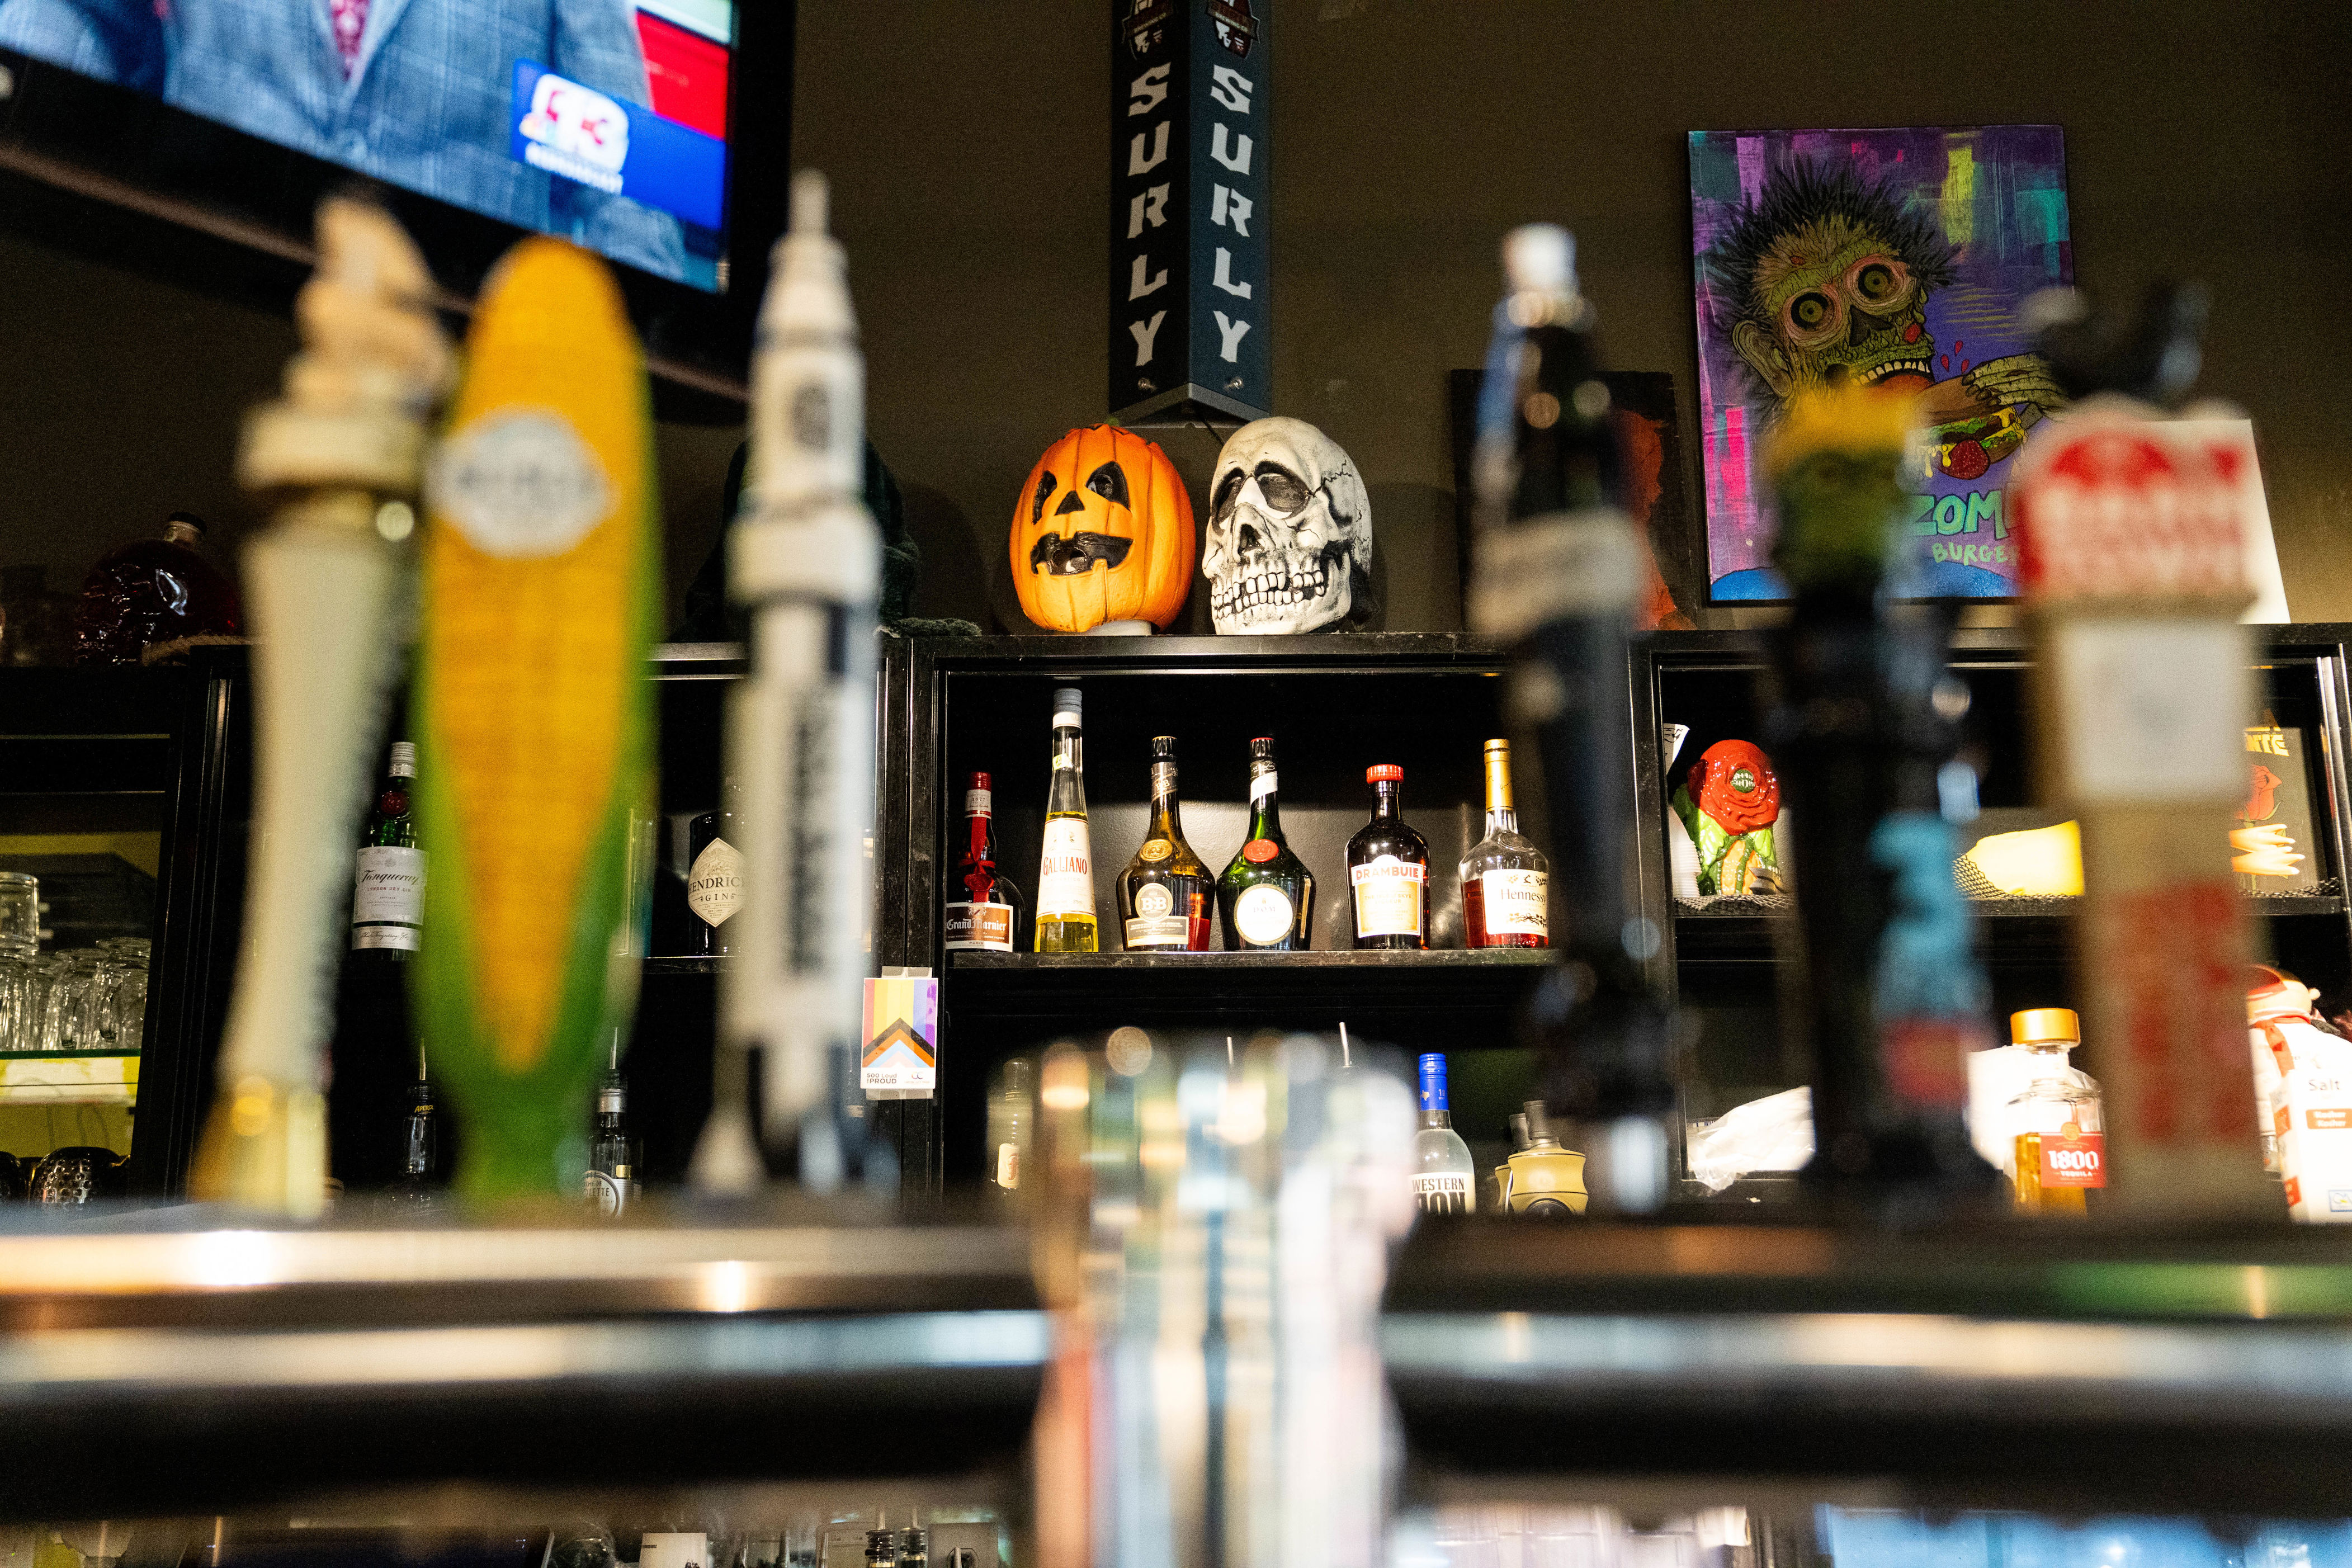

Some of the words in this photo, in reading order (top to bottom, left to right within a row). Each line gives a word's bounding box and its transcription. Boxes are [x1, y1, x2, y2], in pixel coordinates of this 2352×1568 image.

[1127, 62, 1172, 367] SURLY
[1210, 64, 1254, 363] SURLY
[1911, 489, 2011, 541] ZOM
[1043, 856, 1087, 876] GALLIANO
[1356, 866, 1419, 881] DRAMBUIE
[362, 870, 419, 886] Tanqueray
[688, 876, 740, 895] HENDRIC
[705, 893, 729, 901] GIN
[946, 918, 972, 931] Grand
[972, 918, 1007, 932] Marnier
[2308, 1078, 2340, 1091] Salt
[2047, 1150, 2099, 1170] 1800
[1411, 1177, 1465, 1192] WESTERN
